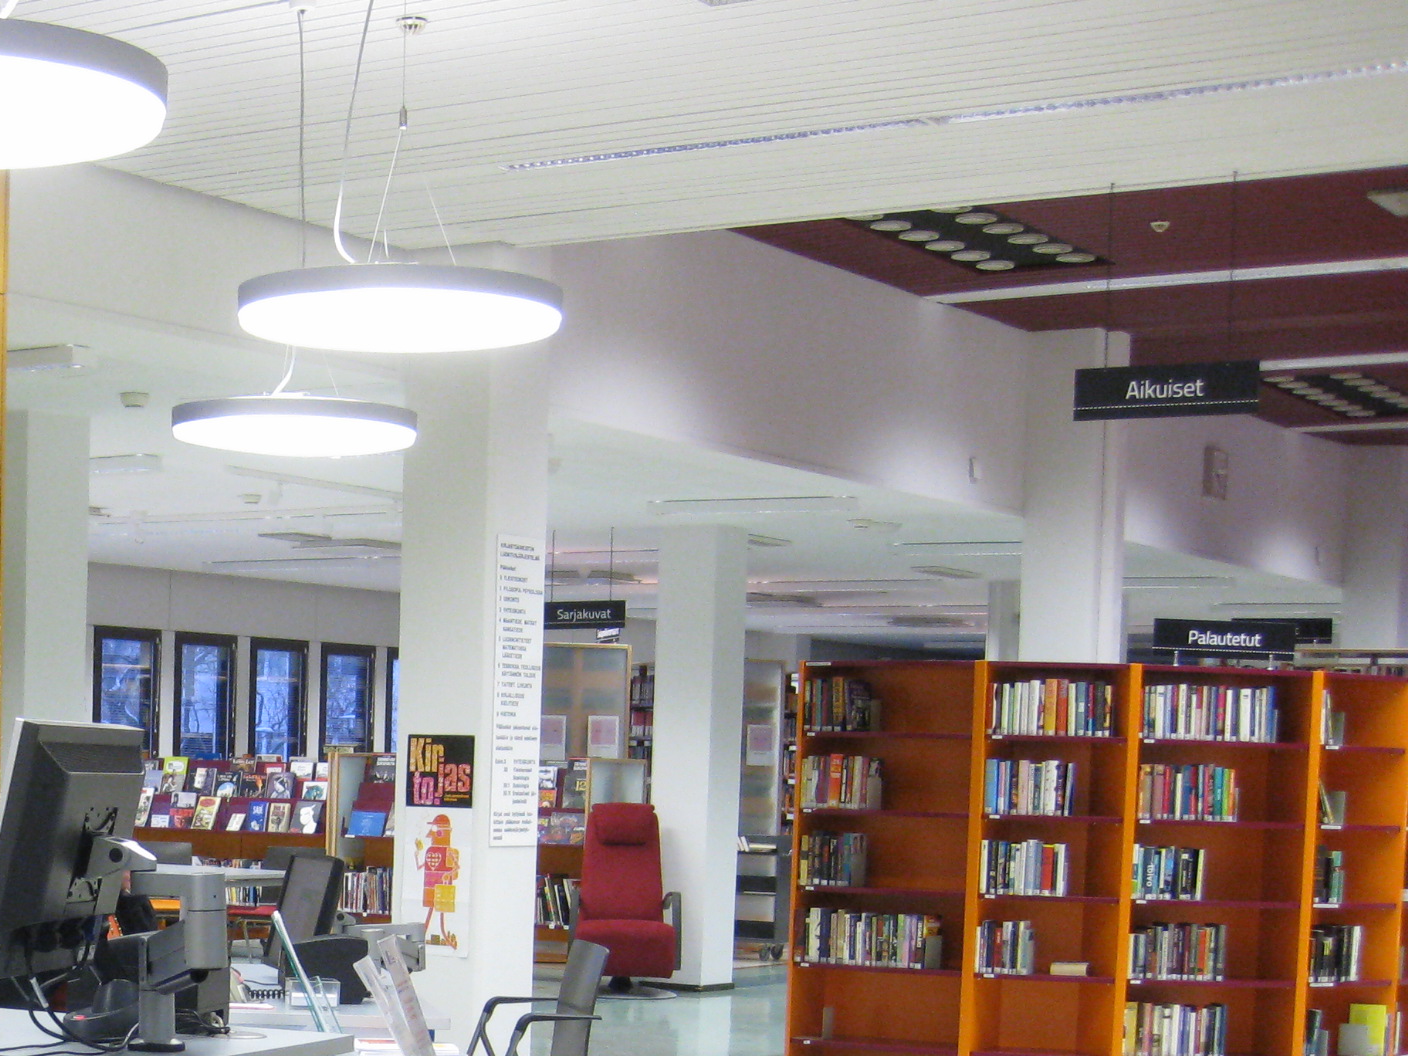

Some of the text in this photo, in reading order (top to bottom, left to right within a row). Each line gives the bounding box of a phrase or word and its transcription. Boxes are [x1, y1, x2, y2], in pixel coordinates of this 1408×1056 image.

[1125, 379, 1205, 400] Aikuiset
[556, 608, 611, 623] Sarjakuvat
[1188, 630, 1262, 648] Palautetut
